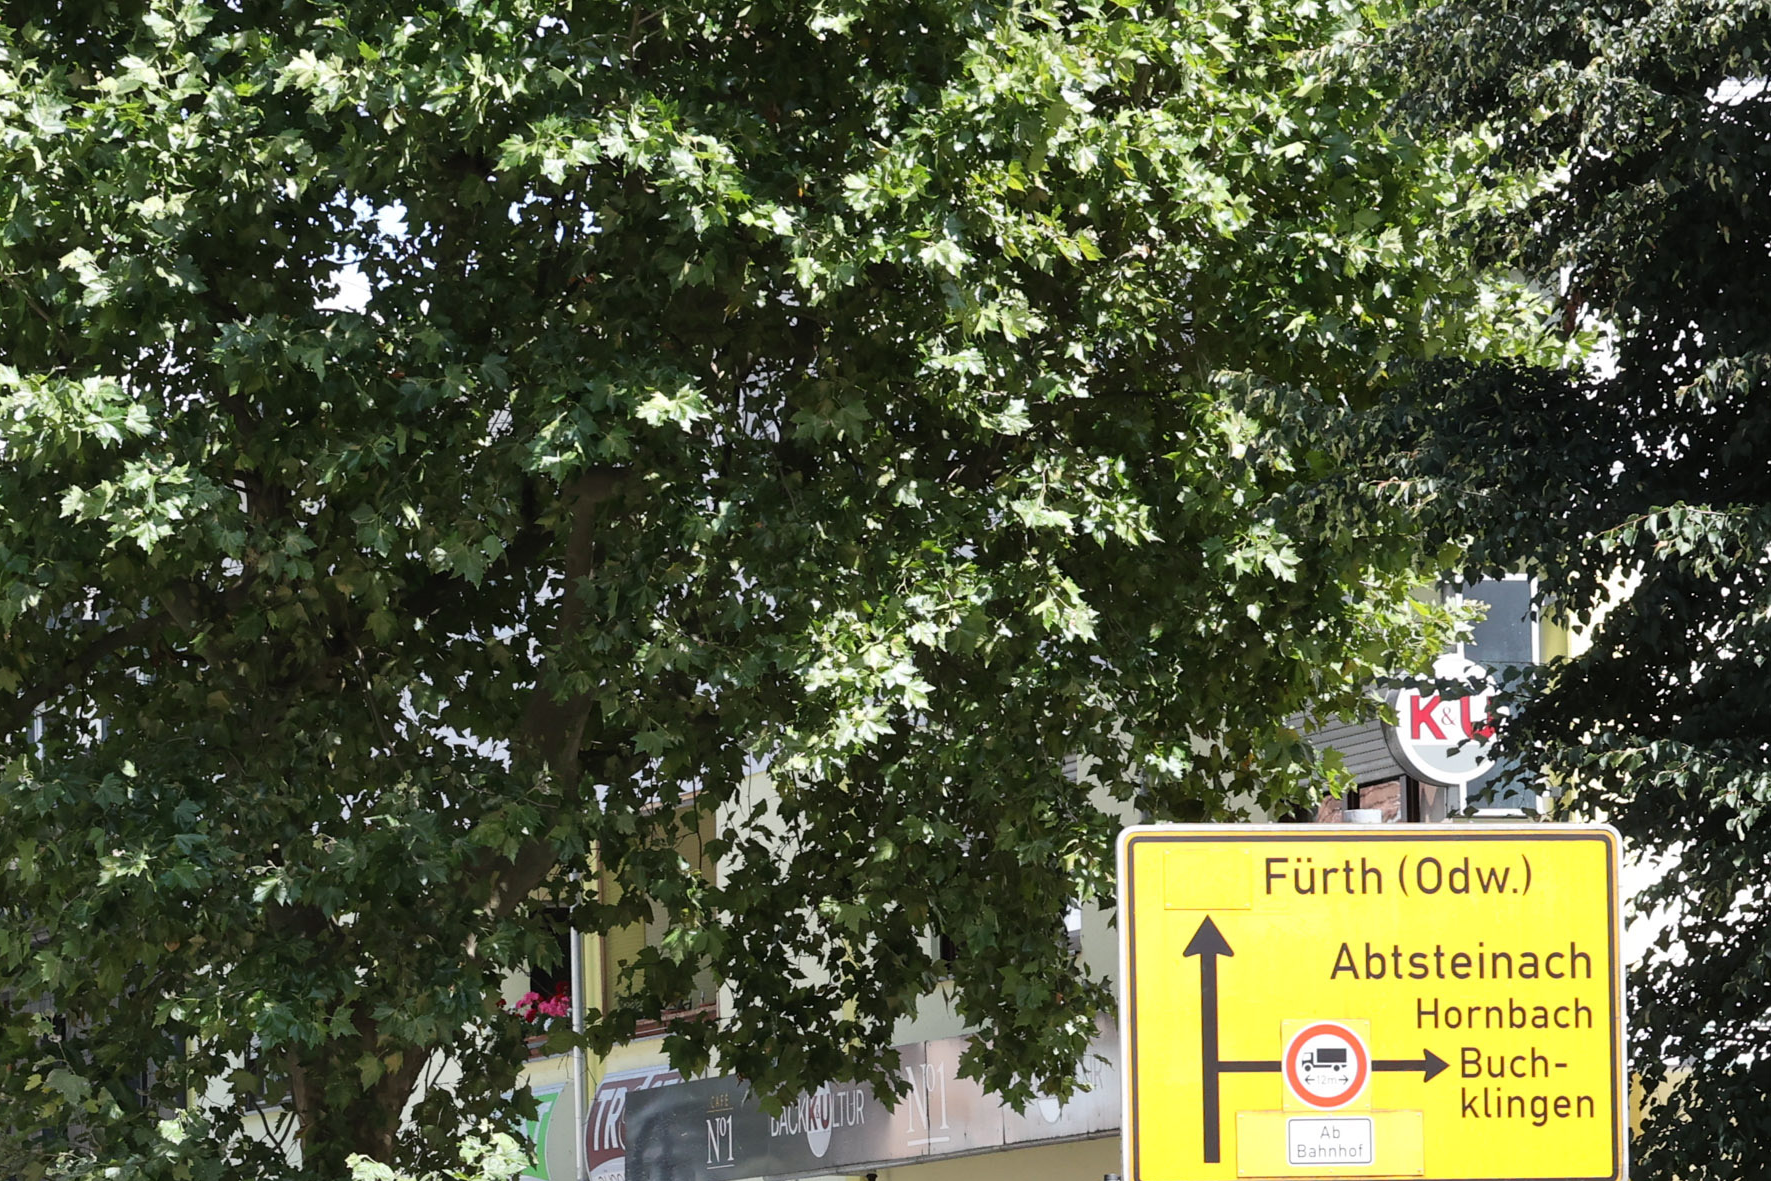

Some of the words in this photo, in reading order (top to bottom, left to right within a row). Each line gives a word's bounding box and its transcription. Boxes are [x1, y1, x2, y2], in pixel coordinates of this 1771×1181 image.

[1264, 857, 1383, 895] Fürth
[1399, 854, 1533, 897] (Odw.)
[1330, 941, 1593, 980] Abtsteinach
[1416, 997, 1593, 1029] Hornbach
[1460, 1046, 1568, 1078] Buch-
[1461, 1087, 1595, 1127] klingen
[1320, 1126, 1341, 1139] Ab
[1297, 1144, 1364, 1158] Bahnhof
